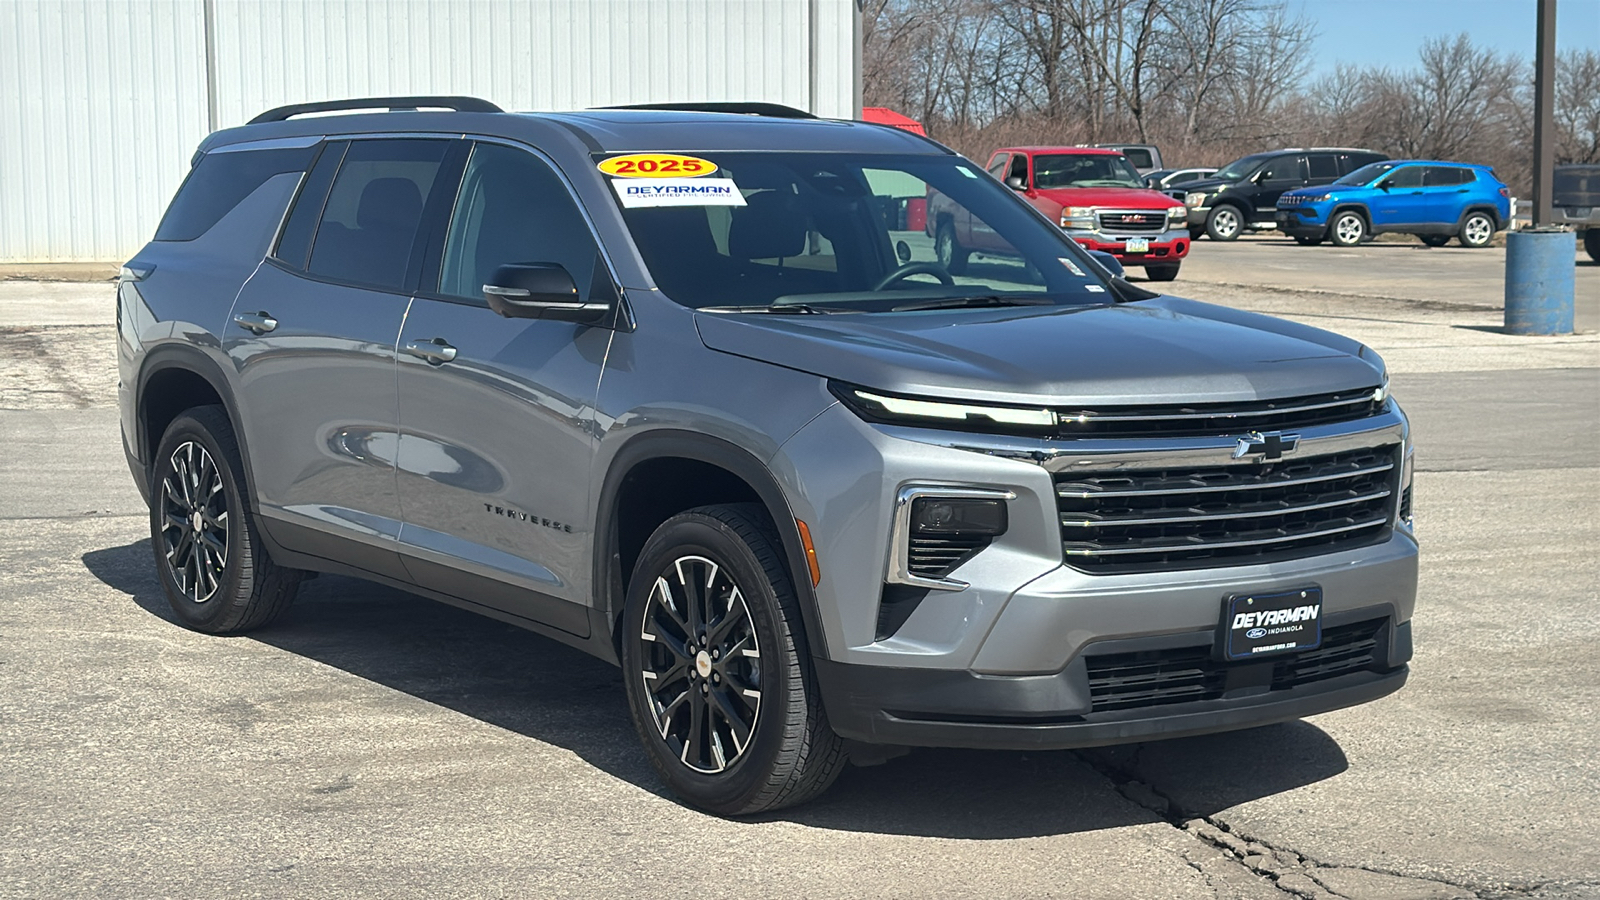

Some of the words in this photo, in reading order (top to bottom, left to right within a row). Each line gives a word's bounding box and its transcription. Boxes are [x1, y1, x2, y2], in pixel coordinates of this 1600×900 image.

[615, 159, 703, 173] 2025
[627, 186, 730, 195] DEYARMAN
[483, 502, 572, 534] TRAVERSE
[1231, 604, 1320, 629] DEYARMAN
[1268, 624, 1304, 635] INDIANOLA
